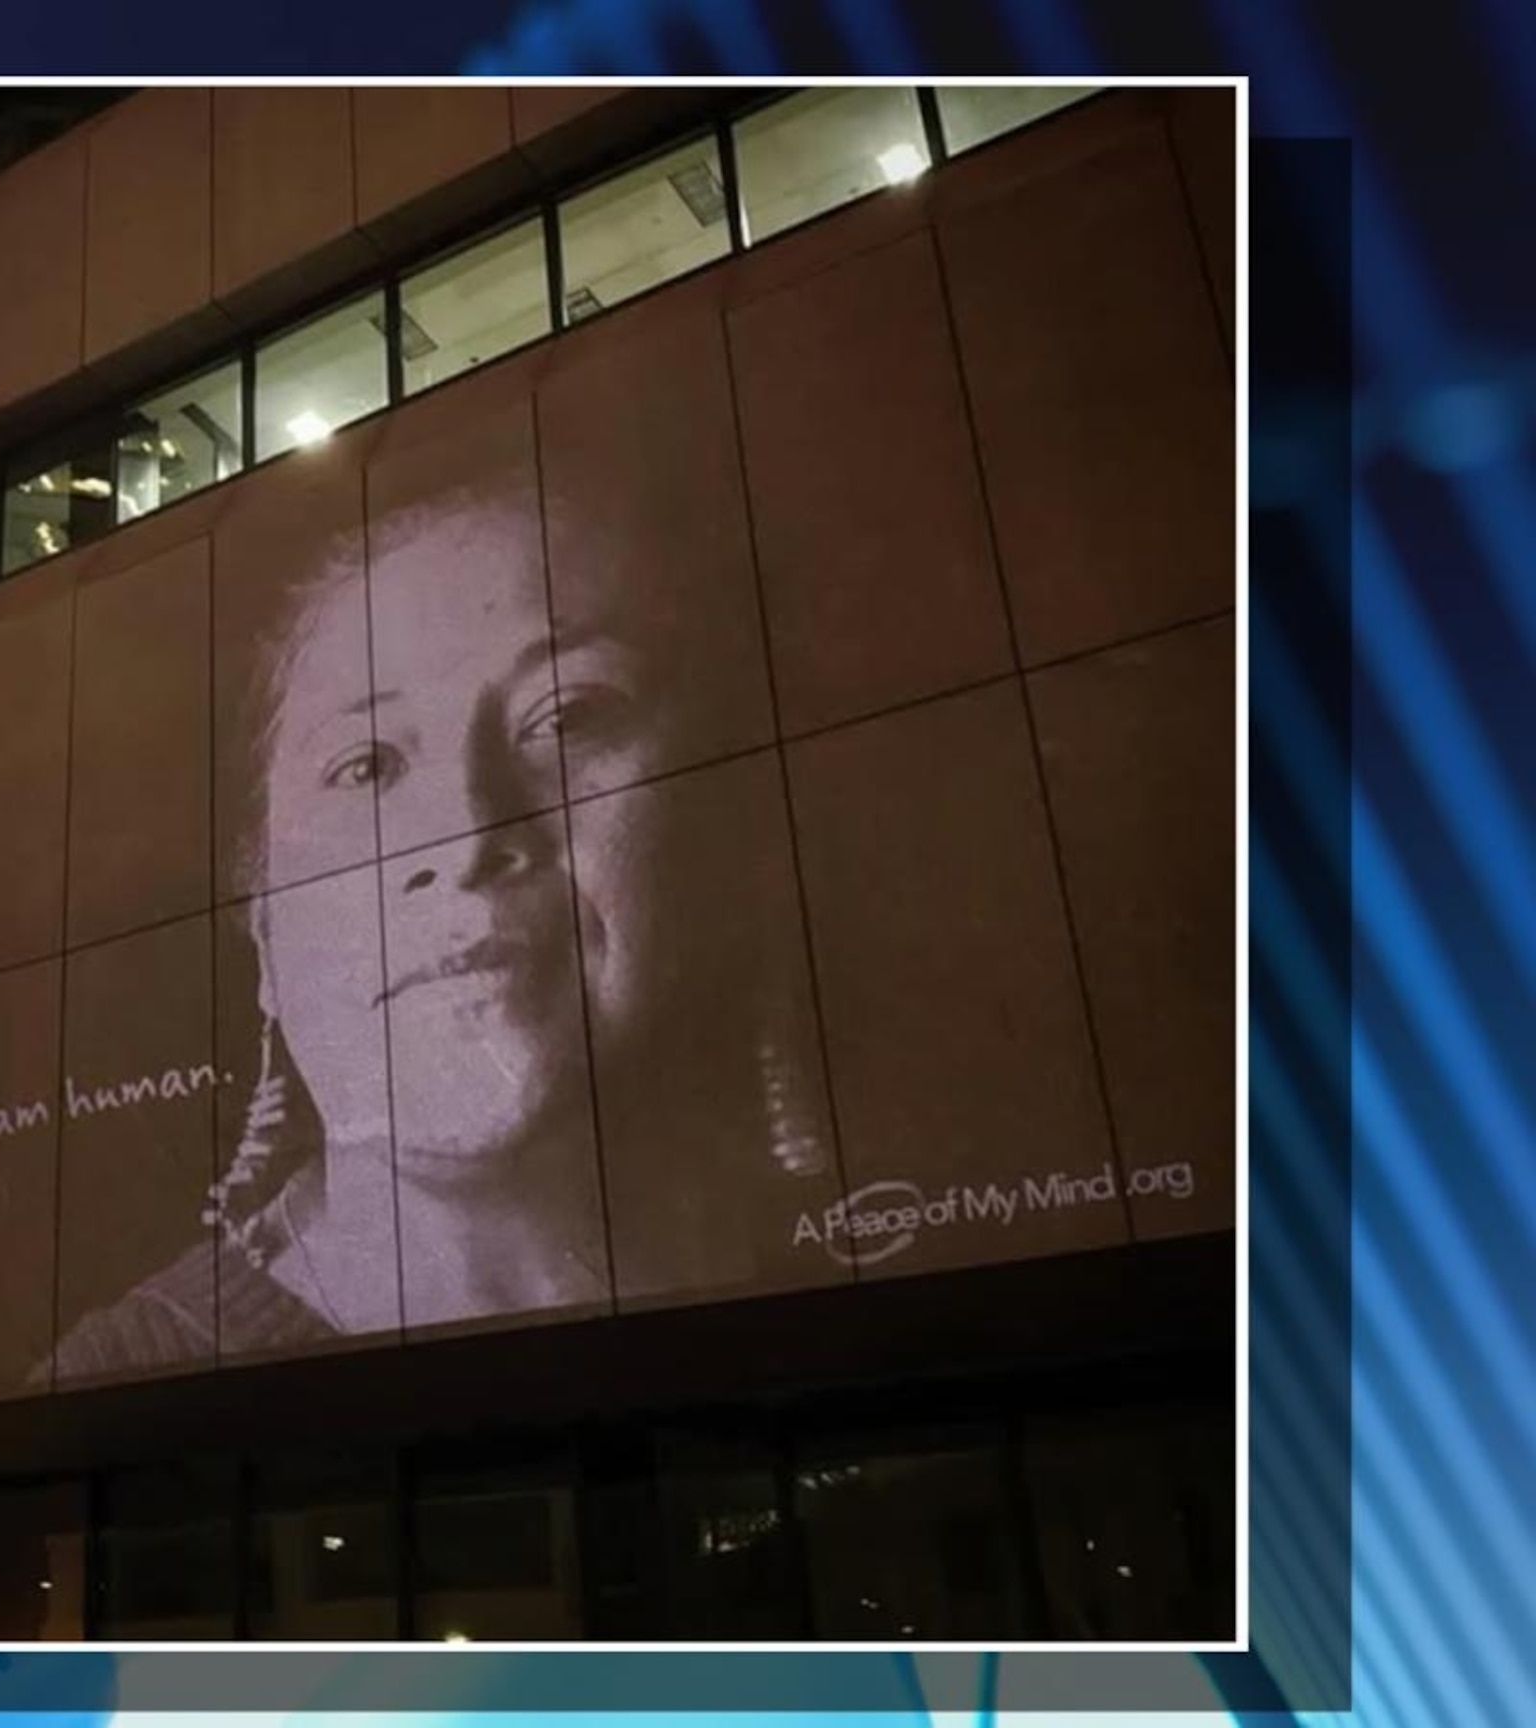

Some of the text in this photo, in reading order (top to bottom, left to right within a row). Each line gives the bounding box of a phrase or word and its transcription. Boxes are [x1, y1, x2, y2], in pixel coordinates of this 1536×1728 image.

[65, 1064, 234, 1118] human.
[792, 1214, 822, 1246] A
[925, 1188, 958, 1226] of
[964, 1186, 1018, 1224] My
